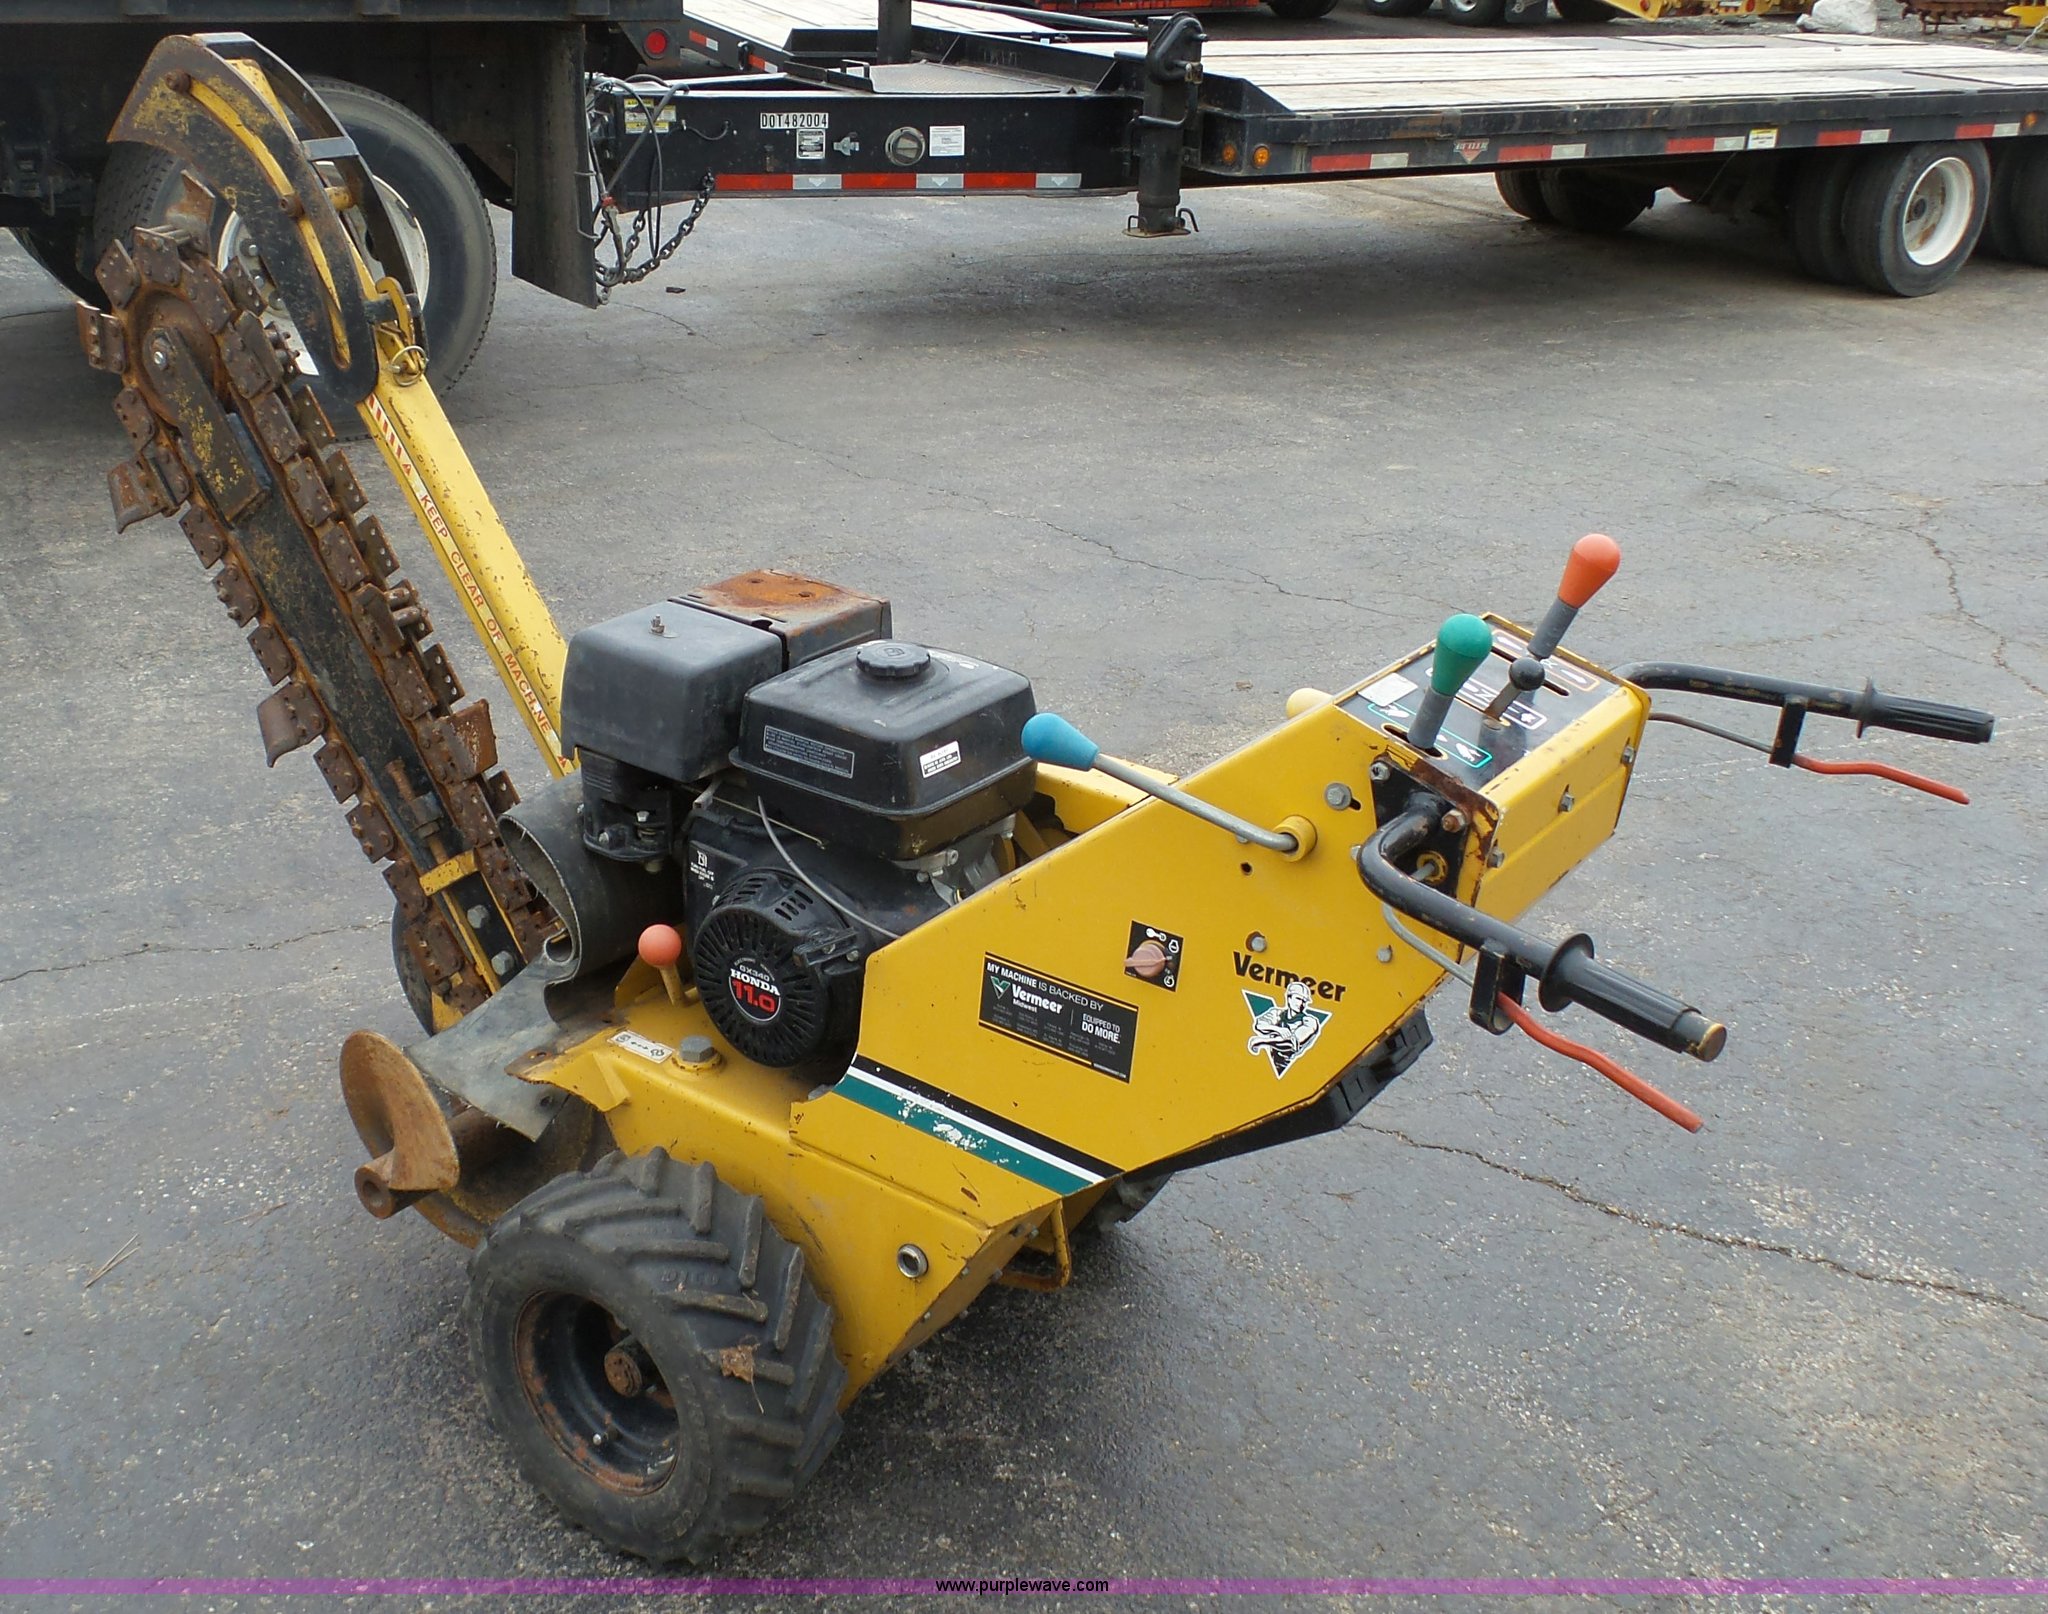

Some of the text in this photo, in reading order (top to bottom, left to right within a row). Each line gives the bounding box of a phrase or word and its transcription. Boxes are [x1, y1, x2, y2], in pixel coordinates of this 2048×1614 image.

[761, 113, 827, 128] DOT482004
[420, 494, 551, 734] KEEP CLEAR OF MACHNE
[730, 968, 781, 996] HONDA
[987, 962, 1104, 1012] MY MACHINE IS BACKED BY
[1233, 951, 1346, 1002] Vermeer
[732, 979, 775, 1013] 11.0
[1012, 984, 1063, 1014] Vermeer
[1013, 999, 1038, 1013] Midwest
[1081, 1021, 1094, 1034] DO
[1094, 1026, 1120, 1044] MORE.
[1082, 1013, 1120, 1033] EQUIPPED TO
